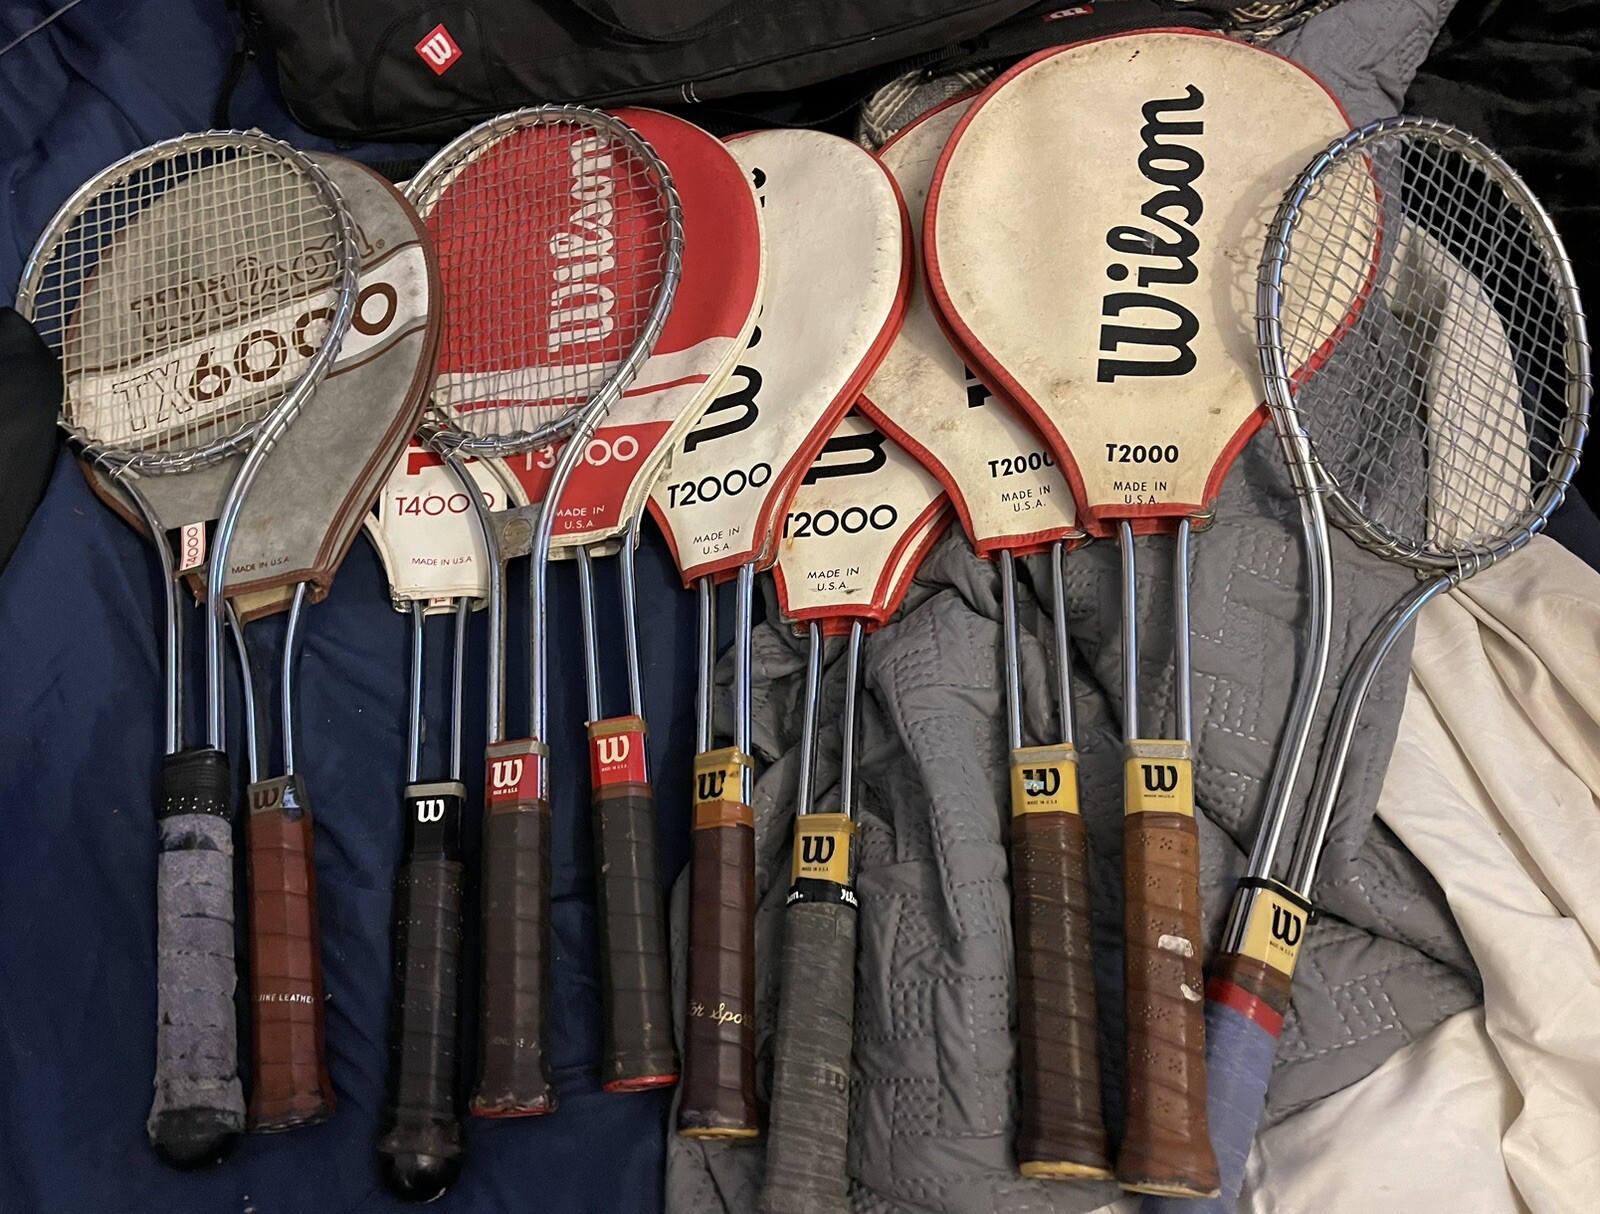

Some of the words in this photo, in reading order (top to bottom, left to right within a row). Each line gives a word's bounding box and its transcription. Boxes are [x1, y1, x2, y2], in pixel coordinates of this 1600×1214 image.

[421, 32, 453, 65] W
[548, 136, 616, 352] Wilson
[1097, 84, 1205, 383] Wilson
[112, 282, 398, 432] TX6000
[1105, 443, 1180, 464] T2000
[667, 462, 772, 509] T2000
[1001, 488, 1034, 502] MADE
[1039, 484, 1051, 495] IN
[1113, 481, 1148, 492] MADE
[1154, 481, 1168, 492] IN
[556, 507, 587, 517] MADE
[593, 505, 605, 514] IN
[783, 504, 898, 539] T2000
[185, 526, 199, 567] T4000
[693, 531, 723, 544] MADE
[728, 526, 740, 537] IN
[231, 564, 256, 575] MADE
[411, 558, 438, 566] MADE
[807, 568, 841, 580] MADE
[846, 566, 860, 576] IN
[596, 735, 630, 764] W
[491, 758, 523, 788] W
[697, 769, 726, 800] W
[1141, 764, 1178, 792] W
[253, 787, 280, 810] W
[416, 799, 445, 823] W
[802, 836, 835, 864] W
[1272, 902, 1302, 947] W
